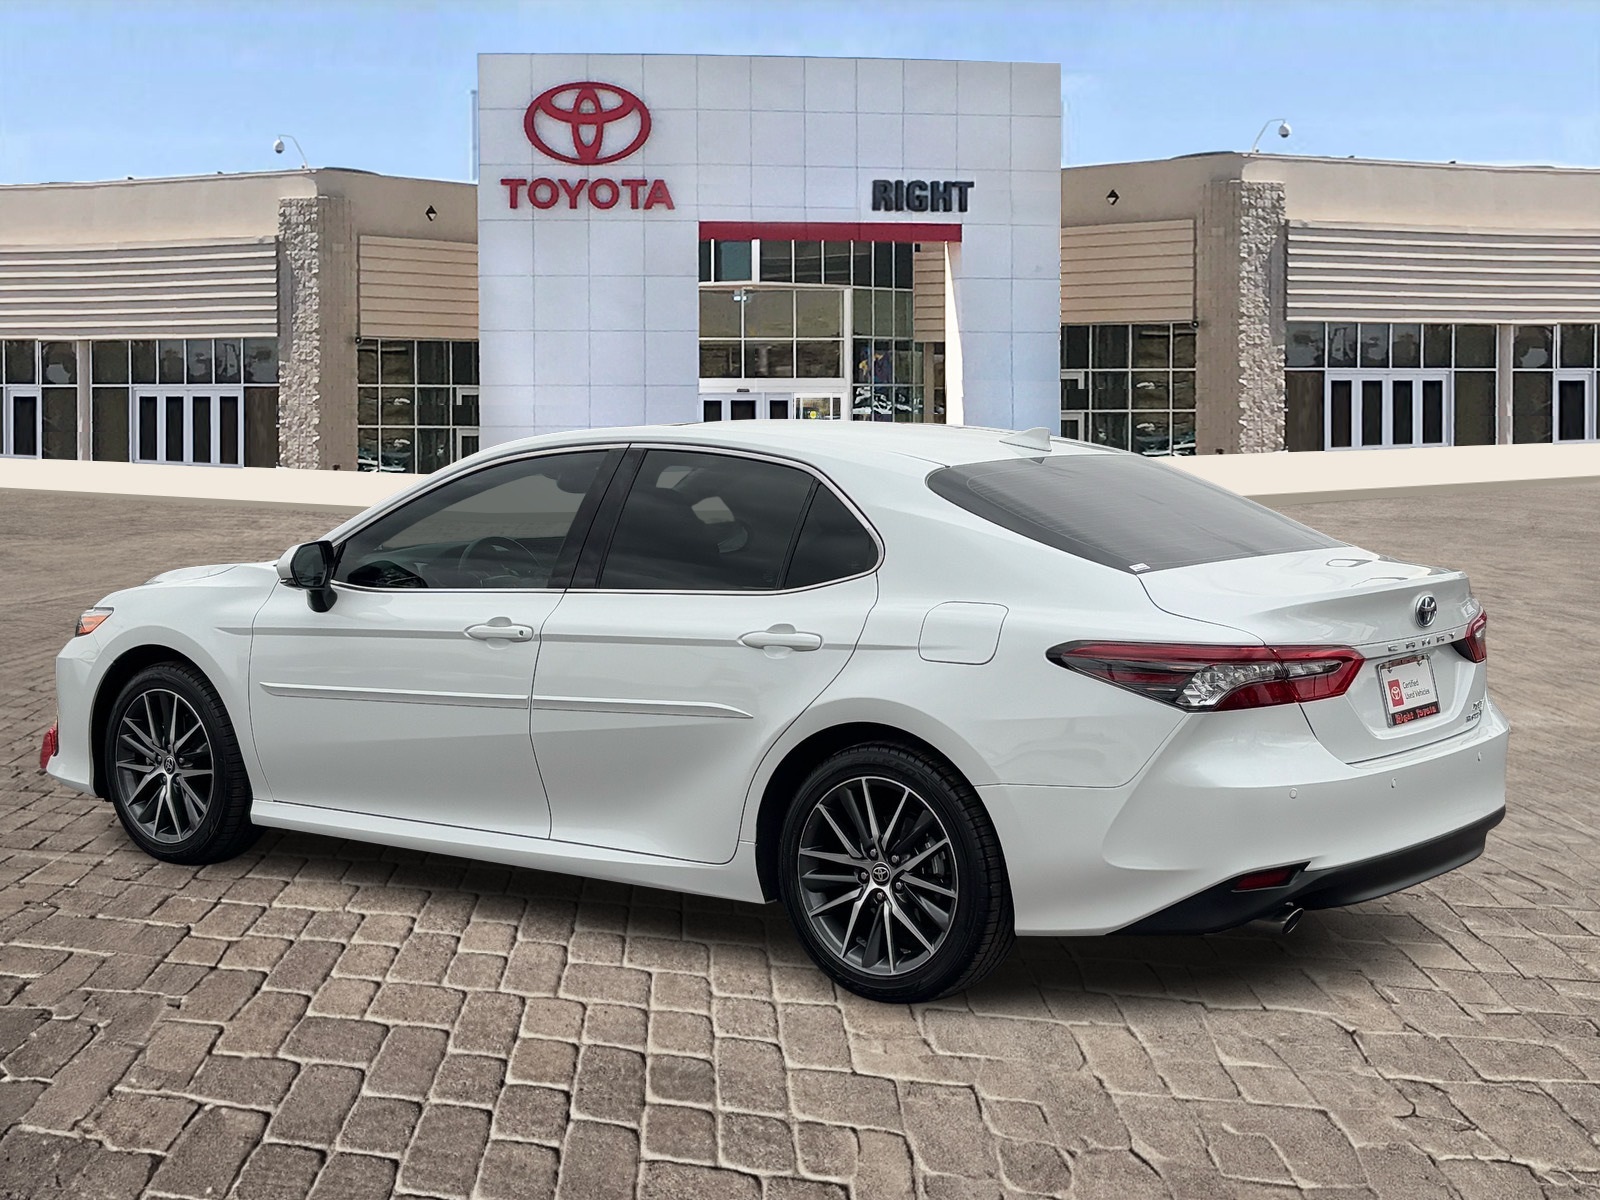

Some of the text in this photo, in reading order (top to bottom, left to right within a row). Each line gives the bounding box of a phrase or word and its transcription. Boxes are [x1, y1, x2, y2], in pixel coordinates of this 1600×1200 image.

[500, 177, 675, 210] TOYOTA
[872, 179, 975, 213] RIGHT
[1402, 679, 1419, 689] Certified
[1405, 688, 1430, 699] Used Vehicles
[1395, 713, 1414, 724] Right
